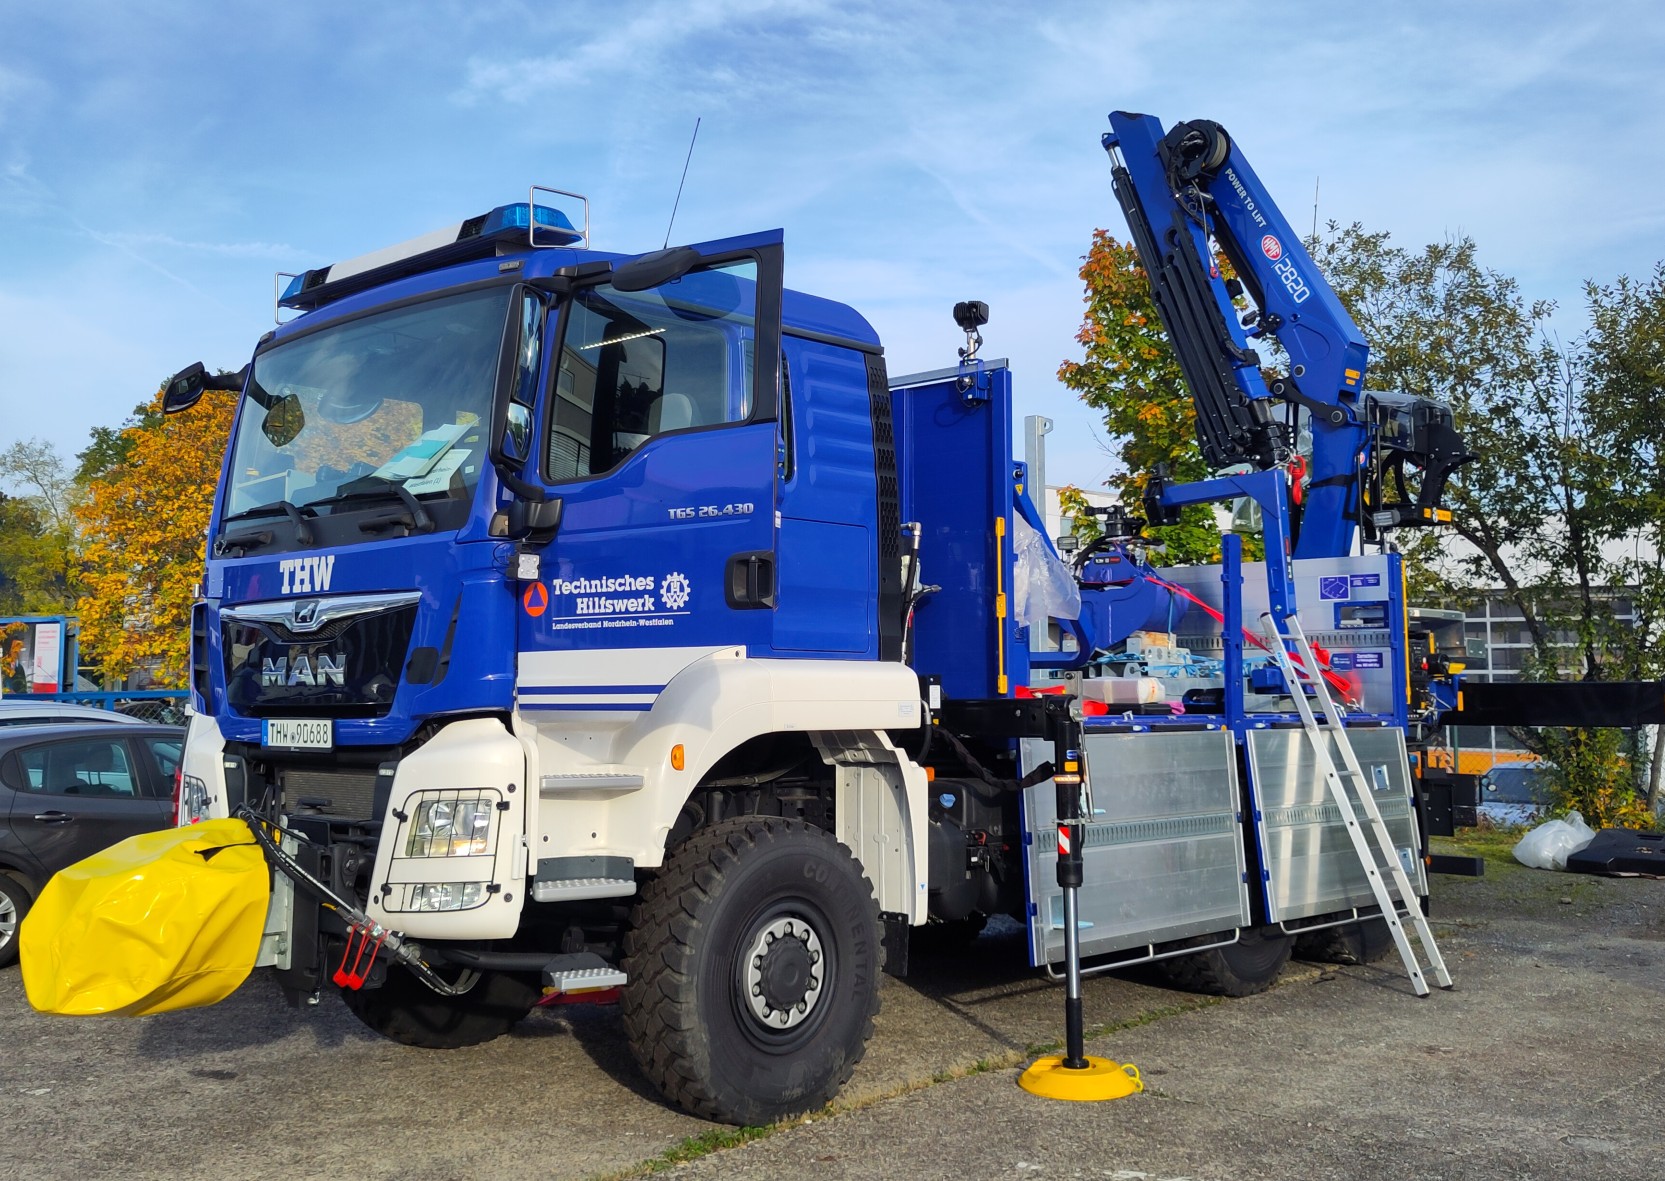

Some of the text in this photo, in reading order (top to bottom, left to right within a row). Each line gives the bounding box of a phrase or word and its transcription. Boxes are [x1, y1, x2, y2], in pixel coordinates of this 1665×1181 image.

[1224, 167, 1267, 229] POWER TO LIFT
[1263, 237, 1281, 258] HMF
[1274, 257, 1311, 304] 2820
[667, 502, 754, 520] TGS 26.430
[279, 554, 335, 594] THW
[552, 574, 655, 595] Technisches
[576, 594, 655, 614] Hilfswerk
[552, 618, 674, 630] Landesverband Nordrhein-Westfalen
[261, 653, 347, 687] MAN
[269, 722, 289, 744] THW
[296, 723, 329, 745] 90688
